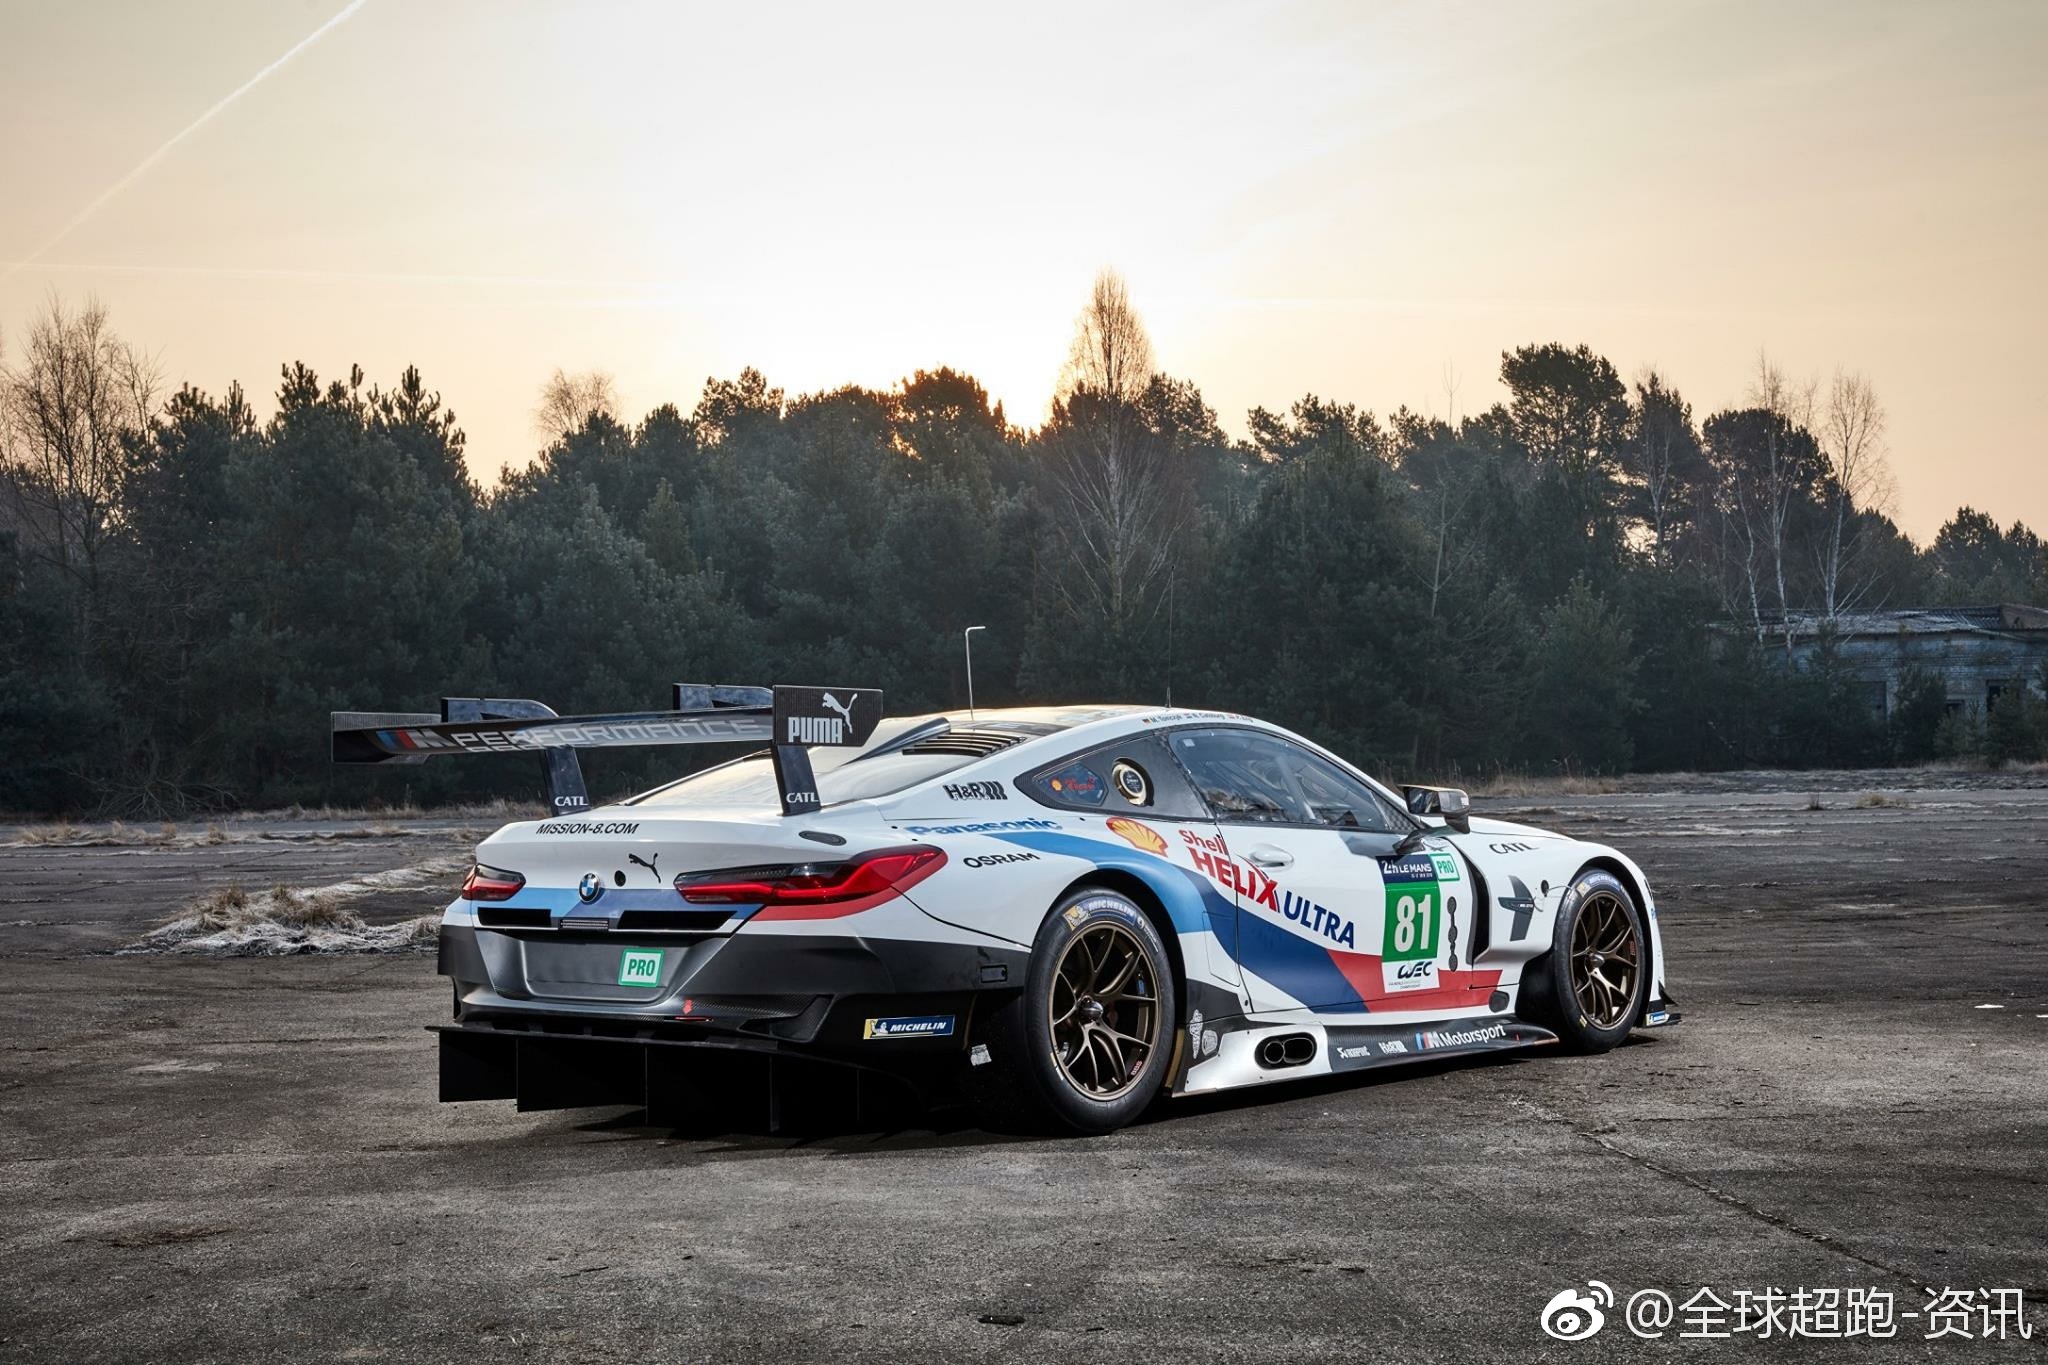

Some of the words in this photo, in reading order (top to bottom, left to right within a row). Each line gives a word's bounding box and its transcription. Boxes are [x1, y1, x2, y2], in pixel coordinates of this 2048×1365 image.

[450, 719, 764, 748] PERFORMANCE
[788, 716, 843, 744] PUMA
[786, 791, 820, 803] CATL
[943, 782, 985, 801] H&R
[554, 796, 590, 807] CATL
[536, 823, 640, 835] MISSION-8.COM
[904, 818, 1061, 835] Panasonic
[1178, 829, 1229, 856] Shell
[1489, 842, 1540, 854] CATL
[963, 852, 1041, 868] OSRAM
[1436, 860, 1455, 874] PRO
[1186, 846, 1281, 913] HELIX
[1284, 890, 1355, 949] ULTRA
[1088, 899, 1136, 918] MICHELIN
[1394, 894, 1431, 953] 81
[627, 959, 656, 976] PRO
[1397, 961, 1433, 979] WEC
[890, 1022, 947, 1032] MICHELIN
[1440, 1024, 1506, 1046] Motorsport
